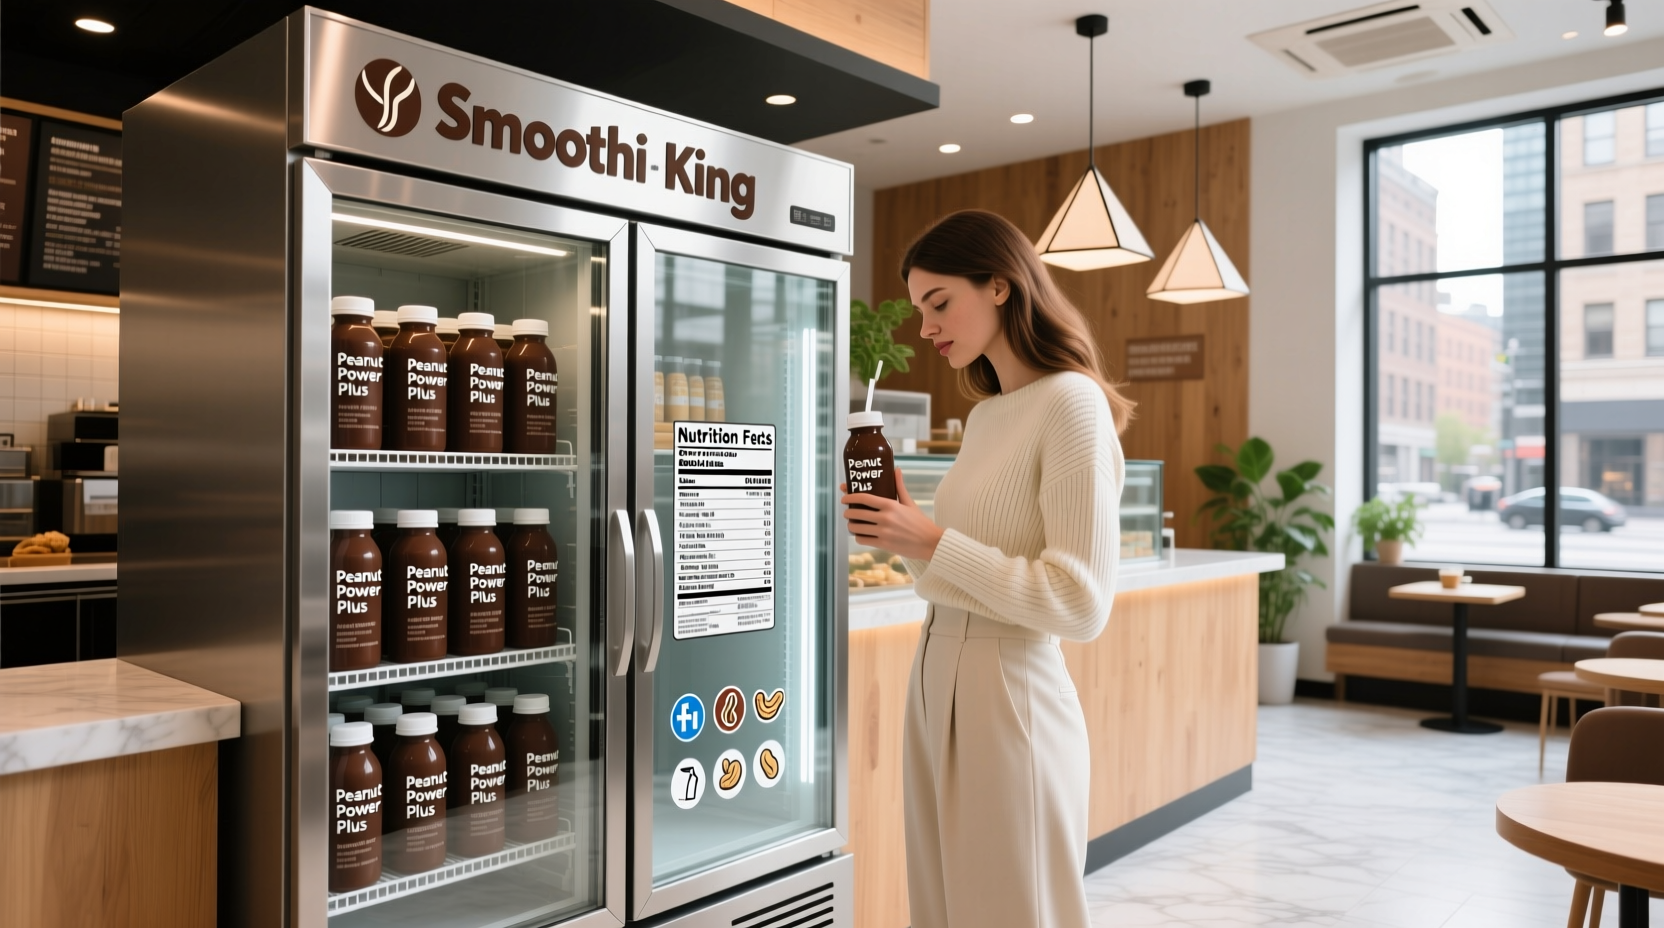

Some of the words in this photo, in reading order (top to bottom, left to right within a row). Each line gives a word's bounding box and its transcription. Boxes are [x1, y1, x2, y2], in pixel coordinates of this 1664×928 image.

[337, 353, 384, 369] Peanut
[407, 359, 448, 373] Peanut
[337, 367, 383, 383] Power
[407, 373, 448, 387] Power
[338, 383, 369, 397] Plus
[407, 387, 437, 400] Plus
[678, 427, 738, 444] Nutrition
[336, 569, 382, 584] Peanut
[406, 565, 449, 579] Peanut
[336, 585, 382, 599] Power
[407, 580, 449, 594] Power
[407, 595, 438, 609] Plus
[470, 591, 497, 604] Plus
[337, 601, 368, 615] Plus
[406, 771, 448, 790] Peanut
[527, 780, 550, 793] Plus
[336, 784, 383, 805] Peanut
[406, 786, 448, 804] Power
[471, 791, 497, 805] Plus
[336, 800, 382, 819] Power
[406, 804, 436, 819] Plus
[336, 820, 368, 835] Plus
